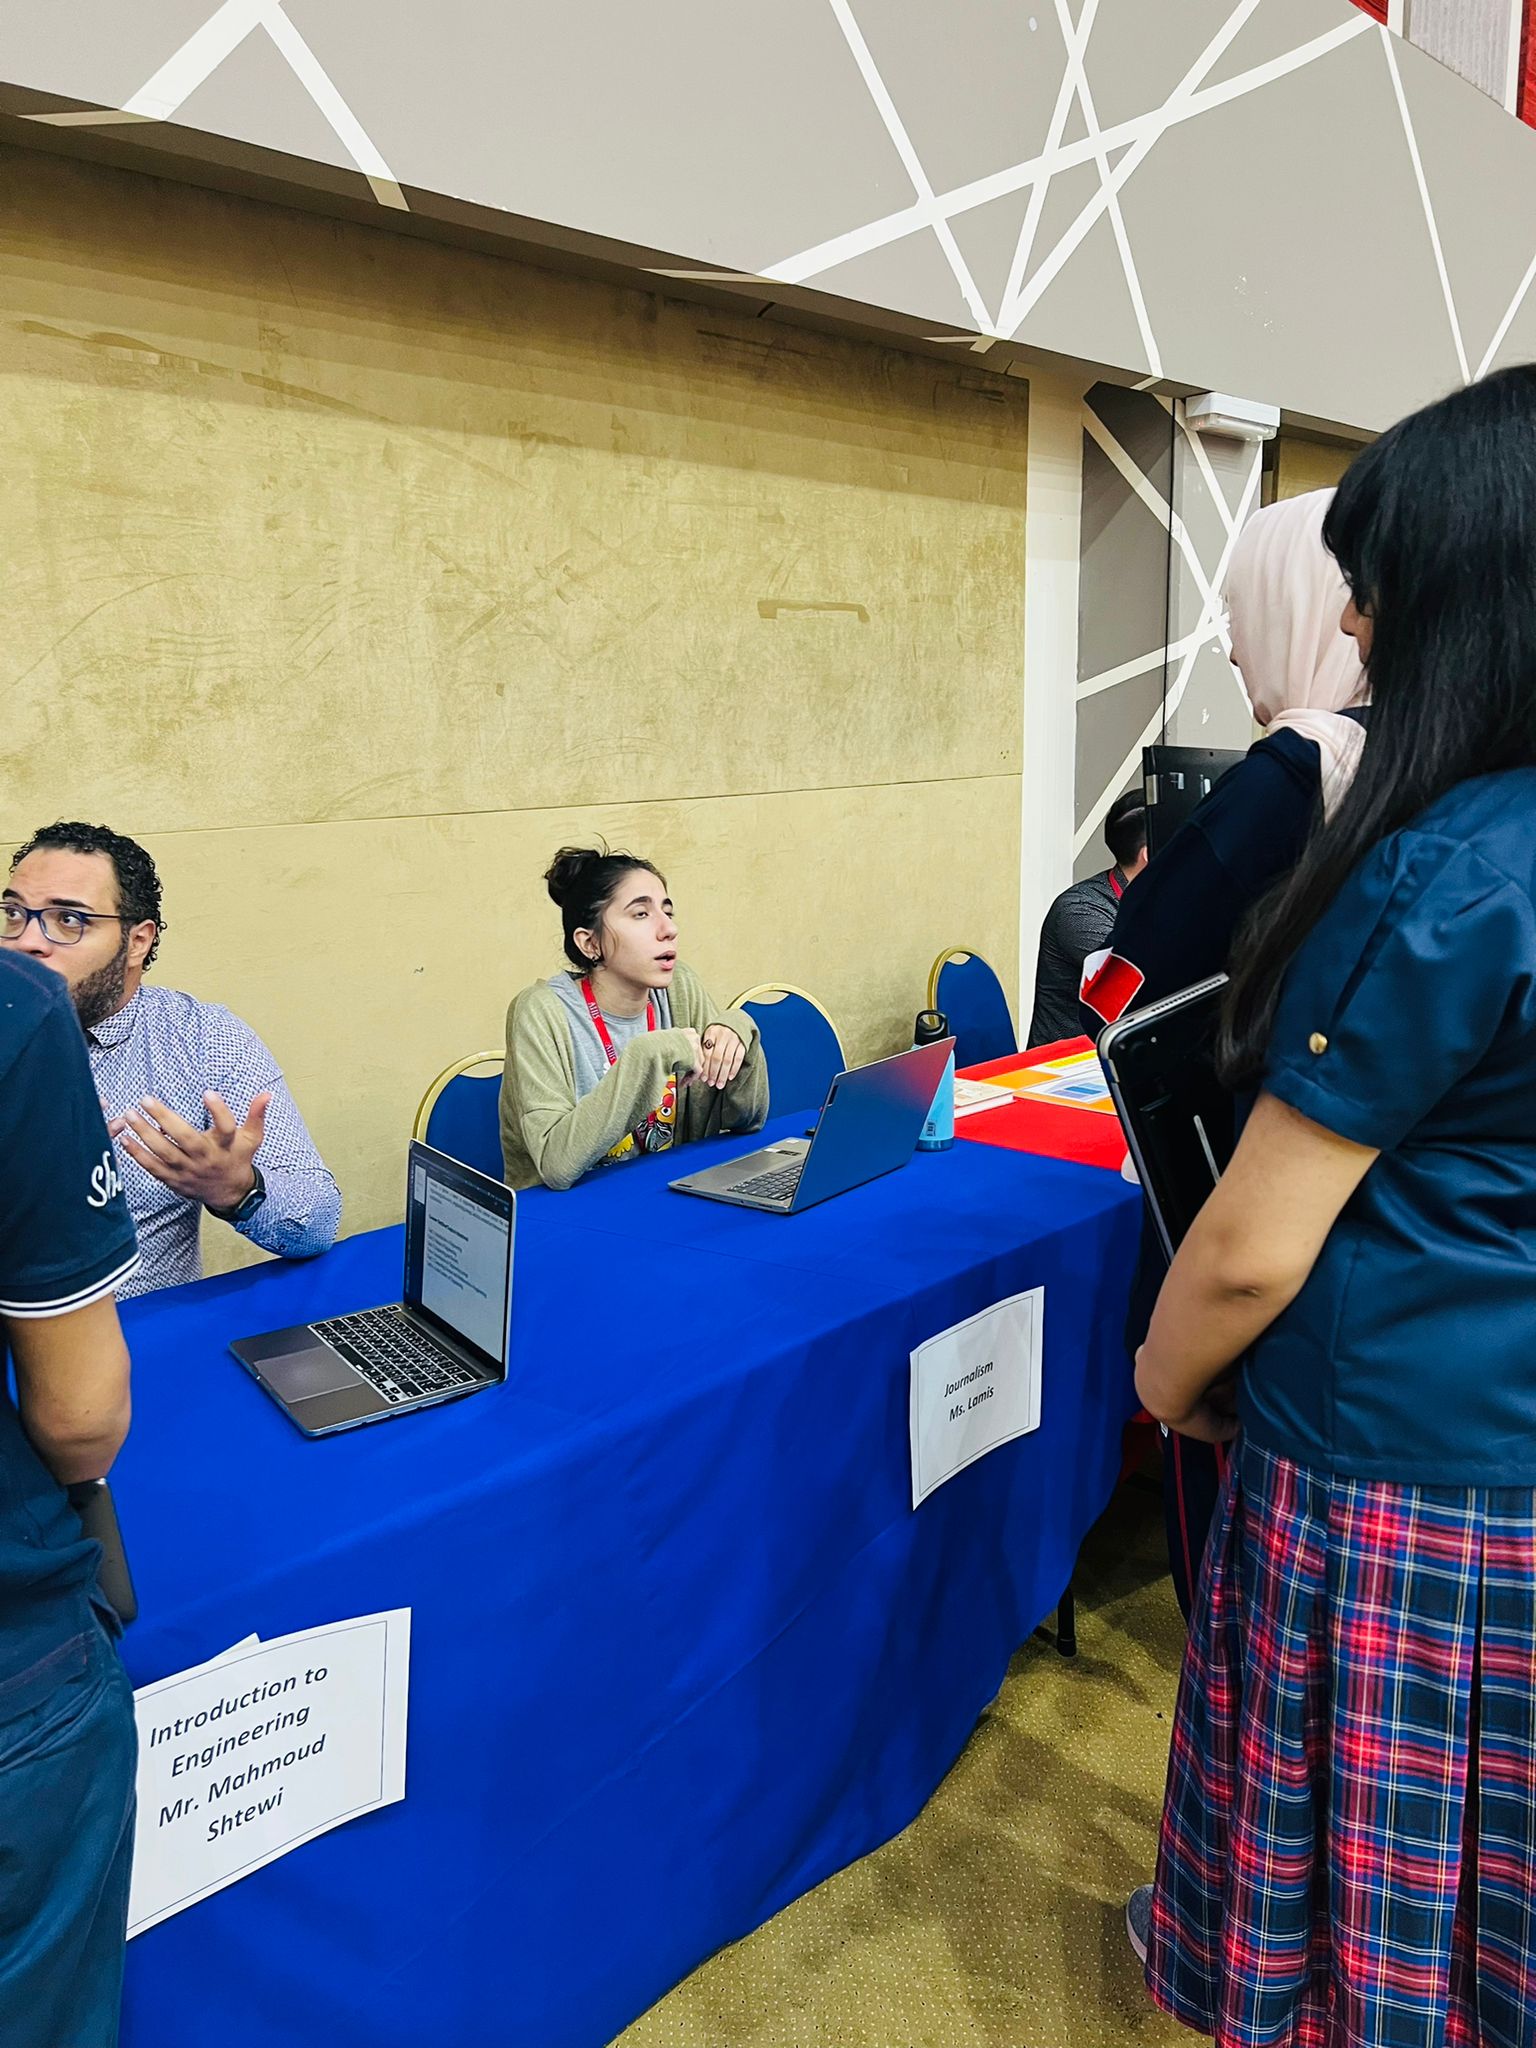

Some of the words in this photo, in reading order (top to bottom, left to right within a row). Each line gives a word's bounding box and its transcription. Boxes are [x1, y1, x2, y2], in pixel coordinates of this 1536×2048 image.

[944, 1360, 994, 1398] Journalism
[949, 1405, 966, 1421] Ms.
[967, 1385, 994, 1409] Lamis
[149, 1677, 297, 1748] Introduction
[304, 1666, 329, 1685] to
[171, 1705, 310, 1778] Engineering
[158, 1798, 200, 1828] Mr.
[207, 1734, 327, 1803] Mahmoud
[206, 1787, 285, 1843] Shtewi
